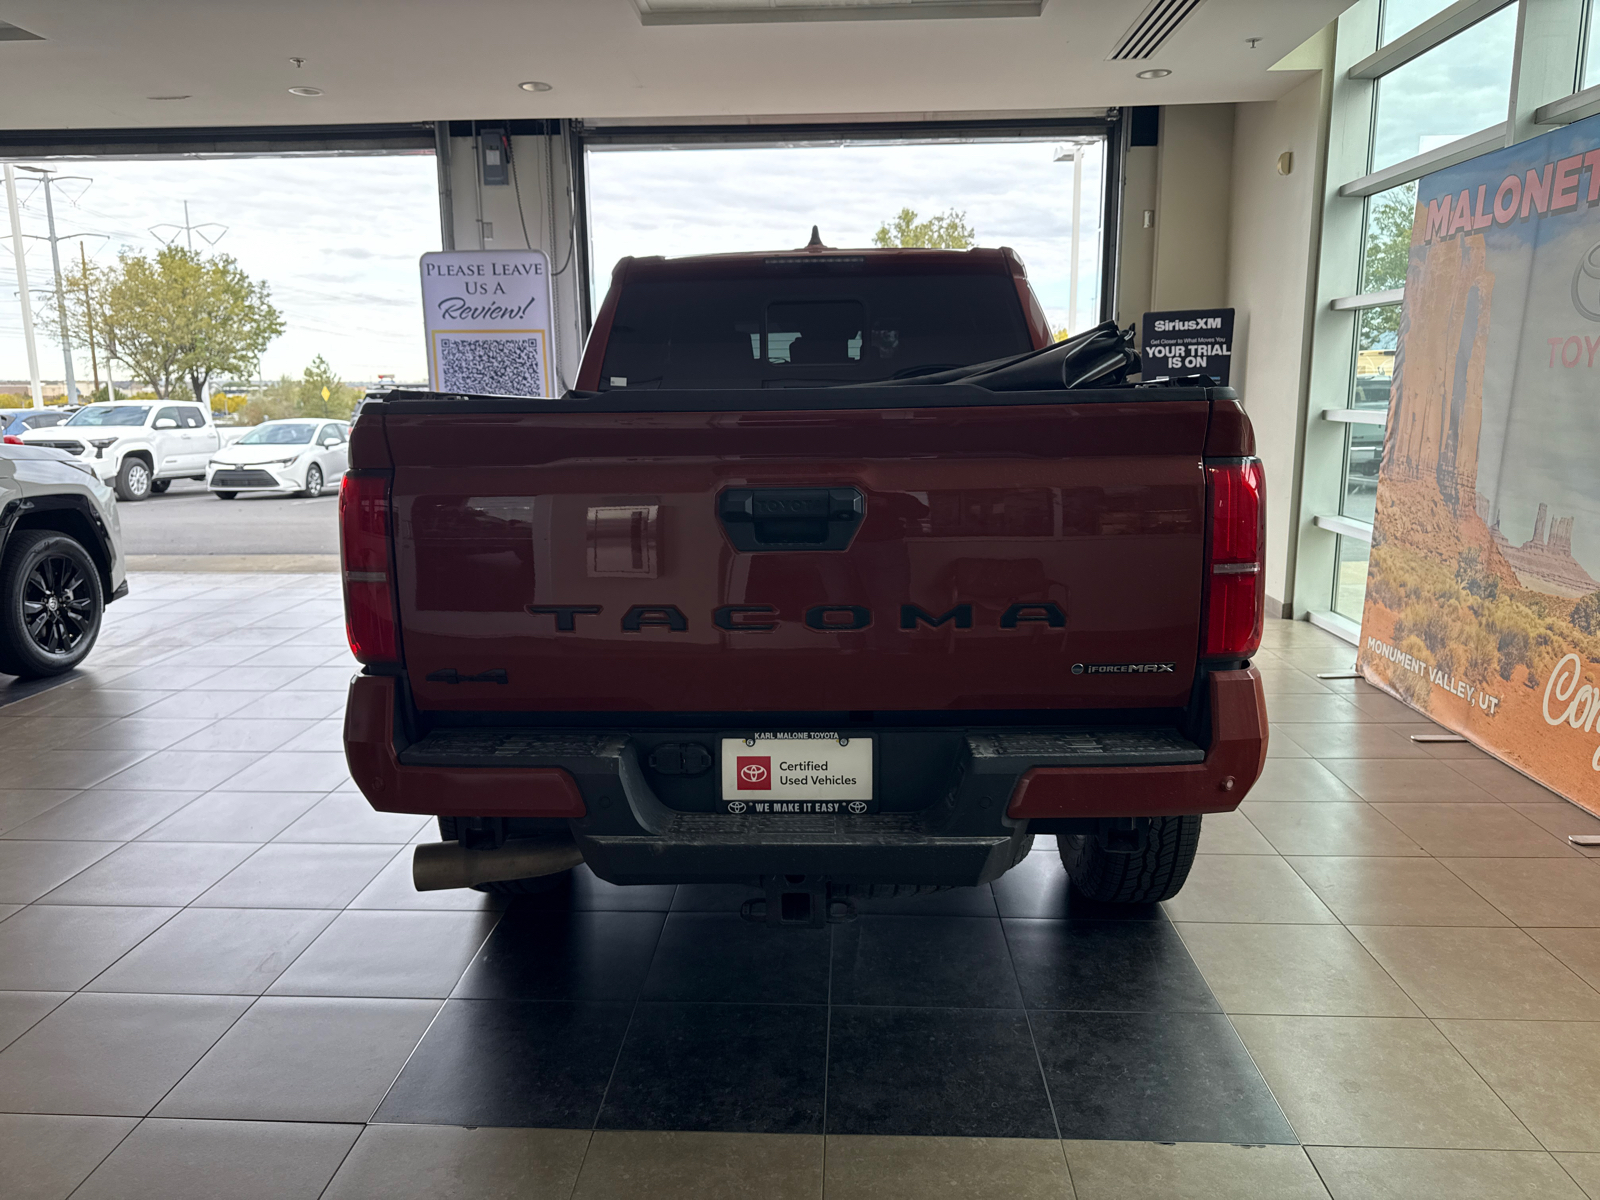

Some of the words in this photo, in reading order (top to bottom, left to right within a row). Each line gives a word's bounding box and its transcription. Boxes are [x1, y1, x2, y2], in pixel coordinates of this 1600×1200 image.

[426, 262, 485, 277] PLEASE
[491, 262, 543, 276] LEAVE
[464, 281, 488, 295] US
[493, 281, 506, 295] A
[437, 296, 536, 320] Review!
[1154, 317, 1222, 332] SiriusXM
[1145, 345, 1185, 358] YOUR
[1188, 344, 1231, 356] TRIAL
[1168, 357, 1182, 369] IS
[1185, 356, 1207, 368] ON
[755, 499, 824, 513] TOYOT
[527, 602, 1068, 633] TACOMA
[1367, 636, 1427, 677] MONUMENT
[1428, 665, 1476, 707] VALLEY,
[1479, 692, 1499, 714] UT
[779, 761, 828, 771] Certified
[780, 775, 808, 785] Used
[810, 775, 857, 785] Vehicles
[755, 803, 770, 812] WE
[773, 803, 800, 812] MAKE
[803, 803, 812, 812] IT
[815, 803, 840, 812] EASY
